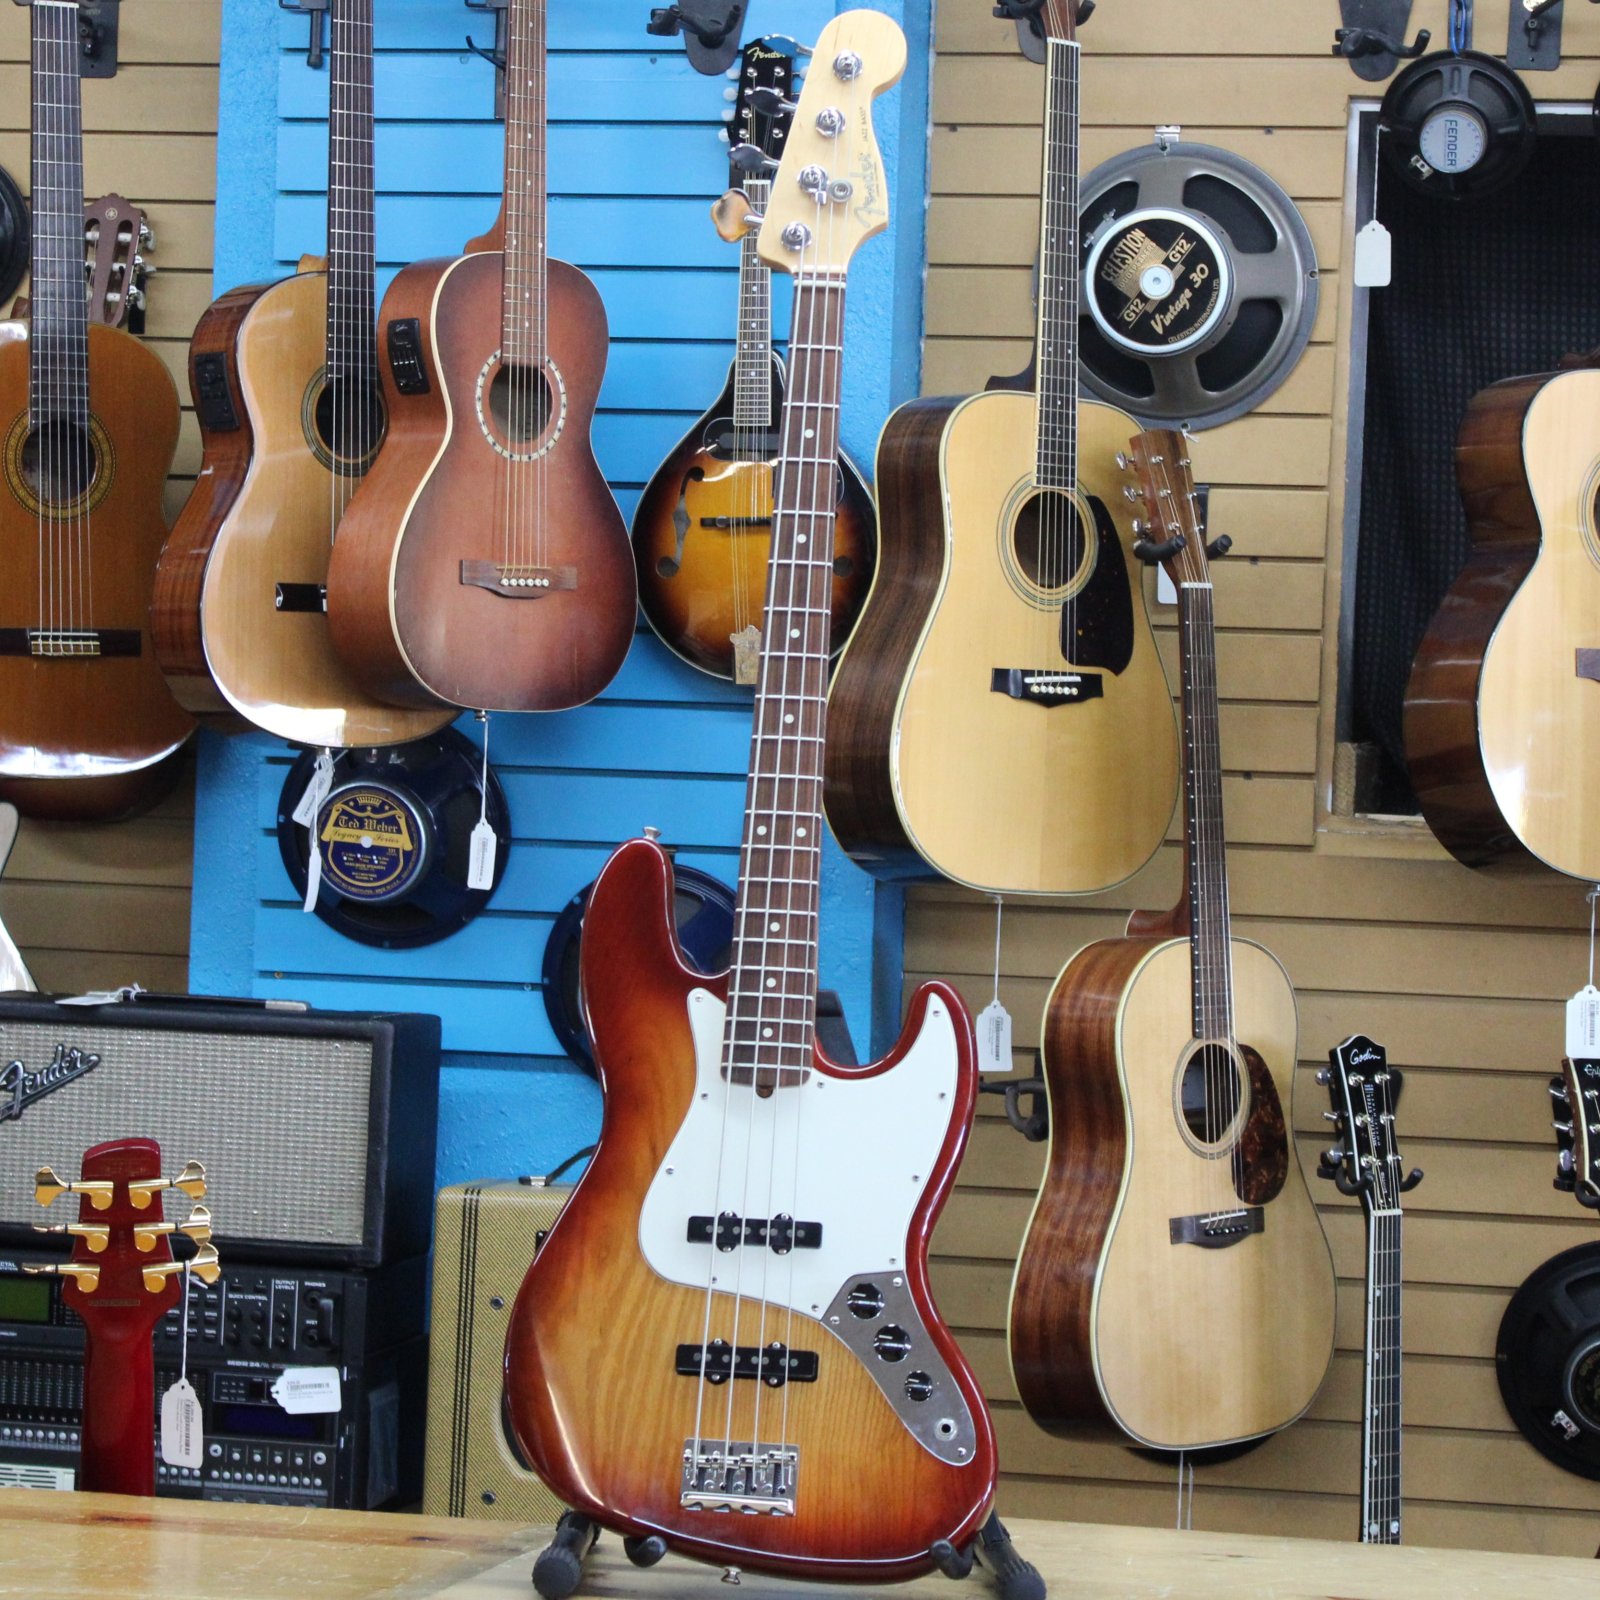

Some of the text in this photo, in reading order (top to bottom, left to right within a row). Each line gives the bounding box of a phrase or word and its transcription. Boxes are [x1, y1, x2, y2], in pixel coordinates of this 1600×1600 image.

[1445, 119, 1458, 167] FENDER
[1101, 228, 1146, 282] CELESTION
[1169, 239, 1191, 262] G12
[1123, 298, 1146, 322] G12
[1150, 263, 1209, 335] Vintage 30
[338, 816, 398, 833] Ted Weber
[1350, 1048, 1381, 1065] Godin
[0, 1043, 102, 1120] Fender
